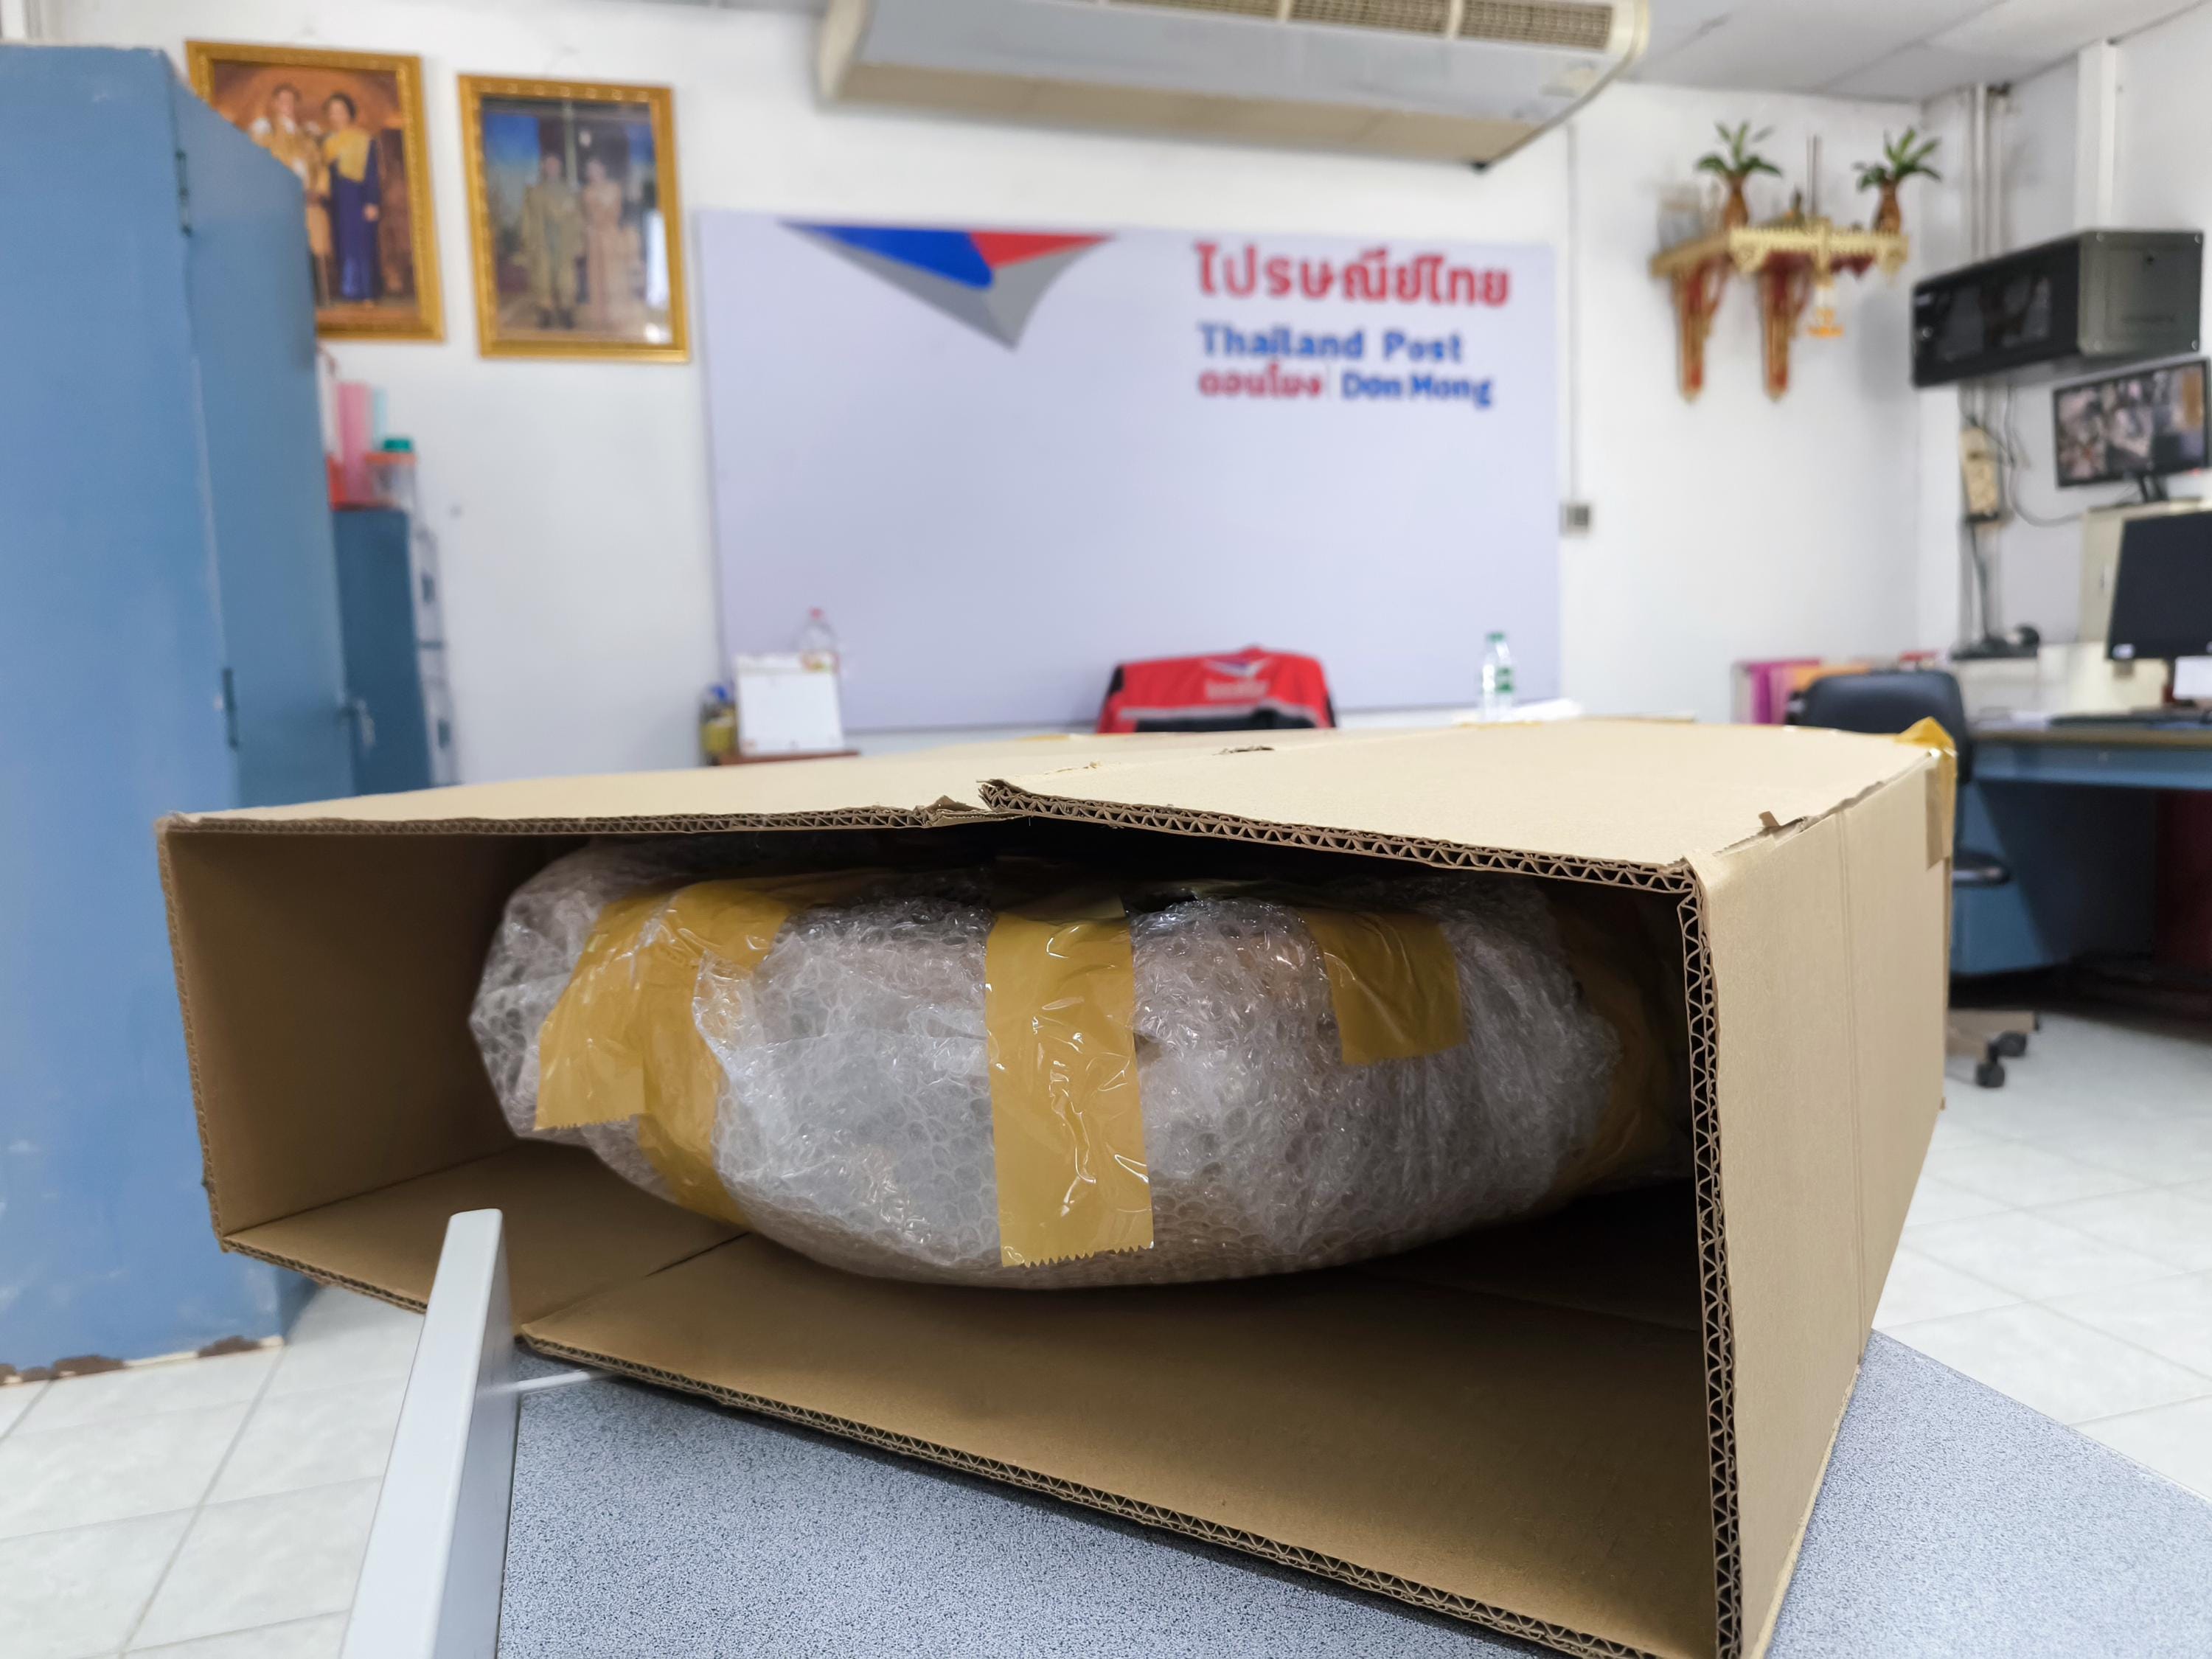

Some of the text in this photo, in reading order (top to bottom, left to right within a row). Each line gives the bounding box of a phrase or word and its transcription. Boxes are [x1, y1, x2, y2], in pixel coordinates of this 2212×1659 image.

[1201, 324, 1462, 362] Thailand Post
[1341, 371, 1402, 399] Don
[1409, 373, 1492, 408] Mong
